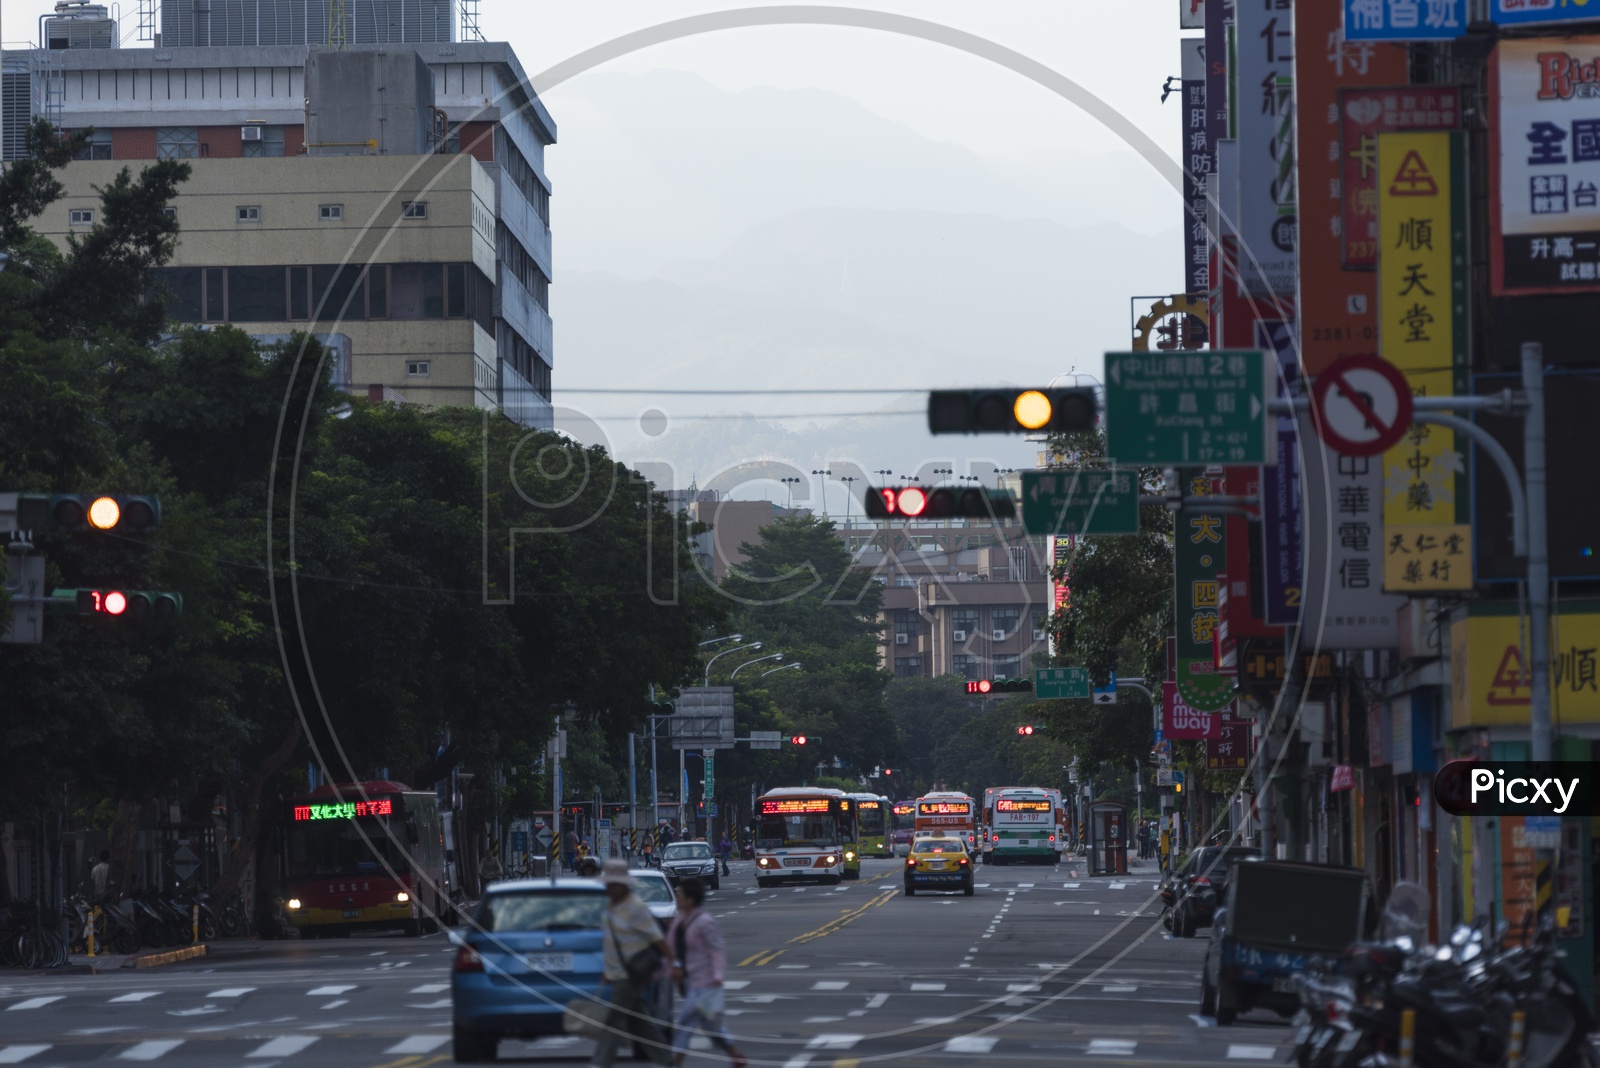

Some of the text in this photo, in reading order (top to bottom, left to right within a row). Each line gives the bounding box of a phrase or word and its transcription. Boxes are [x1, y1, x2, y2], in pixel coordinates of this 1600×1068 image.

[1527, 121, 1600, 166] 全國
[1530, 237, 1600, 259] 升高一
[1396, 217, 1435, 343] 順天堂
[1560, 261, 1600, 280] 試聽
[1337, 455, 1371, 589] 中華電信
[1389, 533, 1465, 556] 天仁堂
[1173, 716, 1212, 735] way
